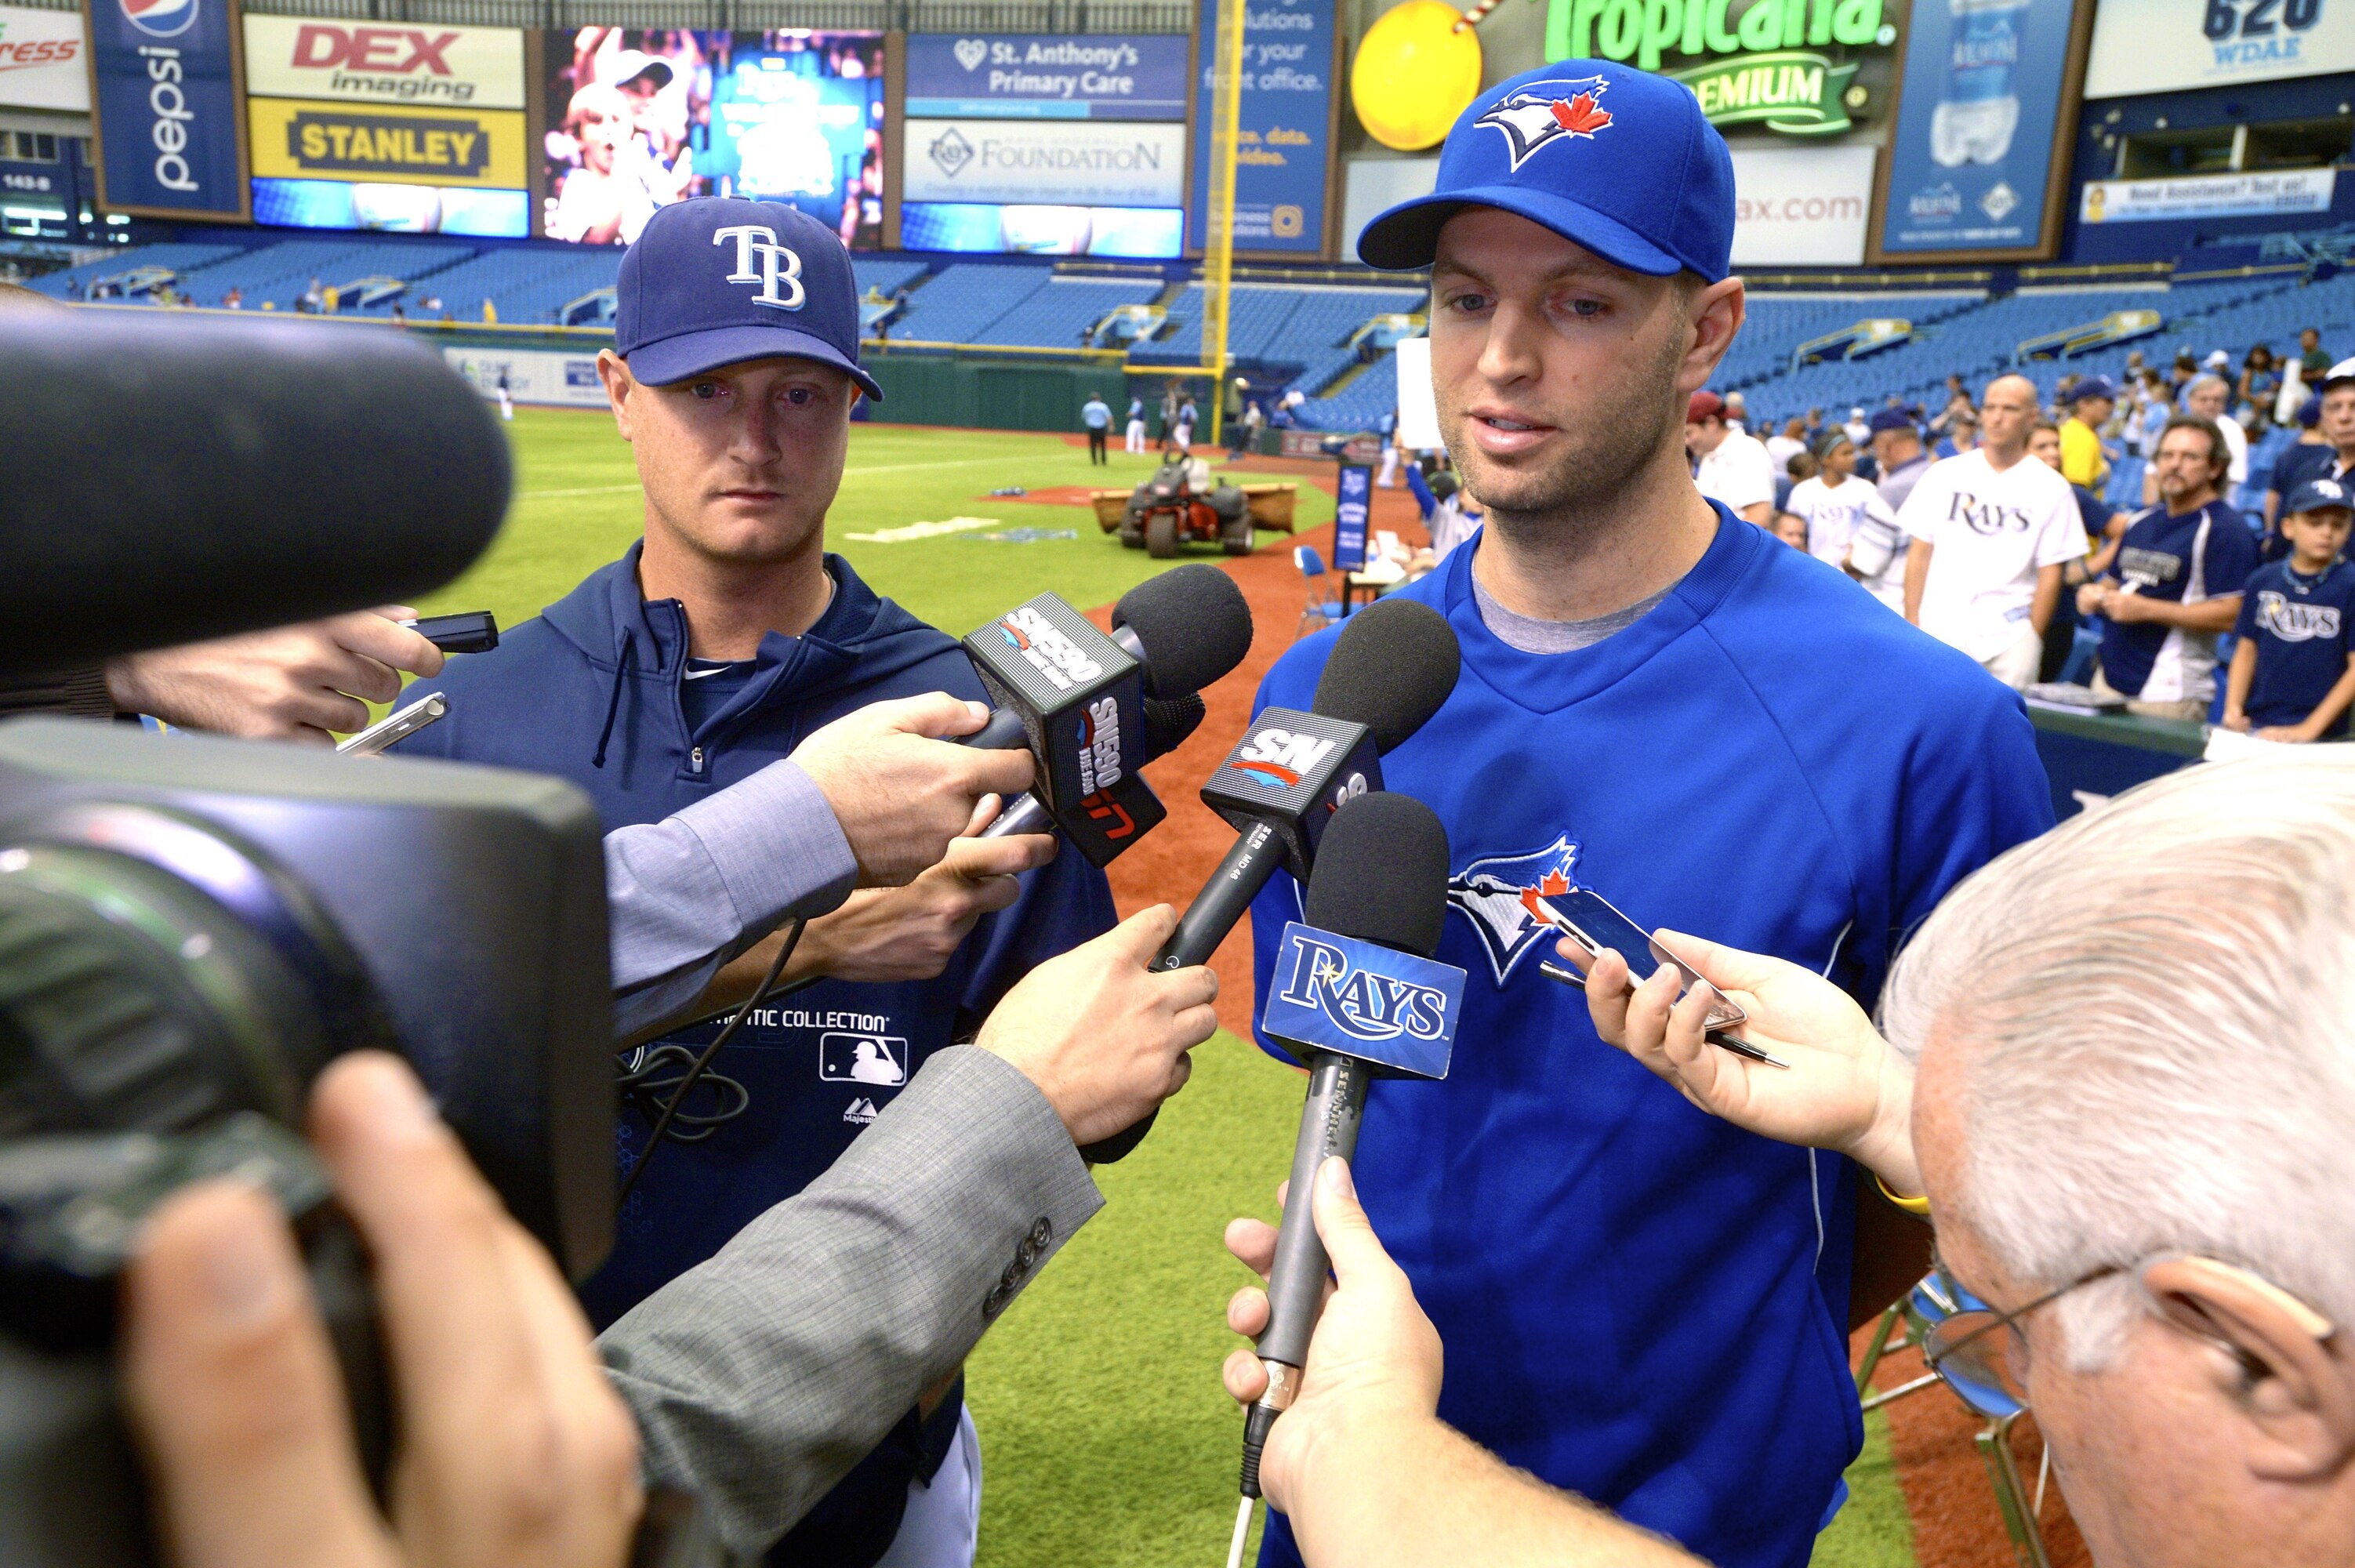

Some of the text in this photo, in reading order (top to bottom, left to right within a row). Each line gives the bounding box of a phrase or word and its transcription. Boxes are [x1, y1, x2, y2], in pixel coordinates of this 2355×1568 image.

[1545, 0, 1881, 70] Tropicana
[2204, 0, 2328, 40] 620
[290, 24, 461, 77] DEX
[991, 41, 1138, 71] St. Anthony's
[1257, 43, 1308, 67] your
[2214, 36, 2302, 65] WDAE
[330, 71, 476, 100] imaging
[989, 70, 1134, 99] Primary Care
[1689, 66, 1824, 113] EMIUM
[138, 45, 199, 191] pepsi
[301, 123, 477, 166] STANLEY
[981, 138, 1162, 170] FOUNDATION
[1736, 195, 1863, 222] ax.com
[713, 225, 806, 312] TB
[1947, 492, 2030, 536] RAYS
[2255, 590, 2341, 641] RAYS
[1090, 696, 1122, 788] SN590
[1240, 728, 1336, 775] SN
[1238, 853, 1253, 869] MD
[1280, 935, 1447, 1041] RAYS
[782, 1010, 886, 1033] COLLECTION
[843, 1113, 873, 1125] Majest
